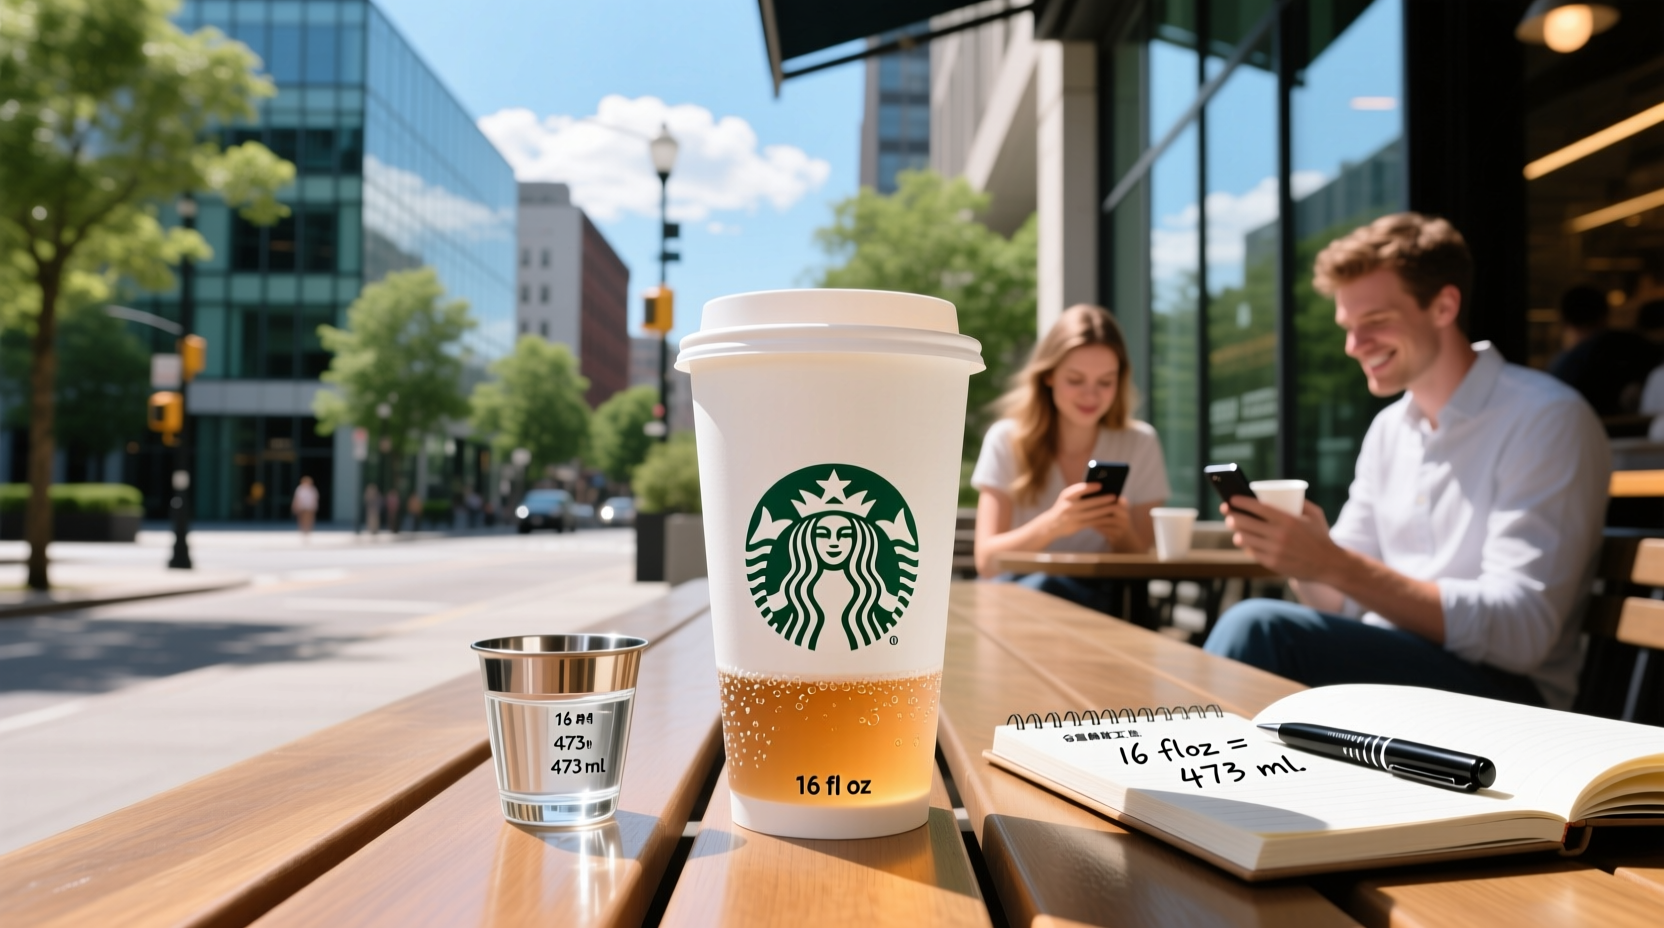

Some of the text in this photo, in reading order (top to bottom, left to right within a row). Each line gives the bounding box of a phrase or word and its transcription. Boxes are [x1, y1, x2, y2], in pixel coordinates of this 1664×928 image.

[555, 711, 572, 726] 16
[1119, 742, 1149, 765] 16
[550, 757, 606, 775] 473 ml
[1180, 763, 1246, 789] 473
[796, 774, 872, 796] 16 fl oz
